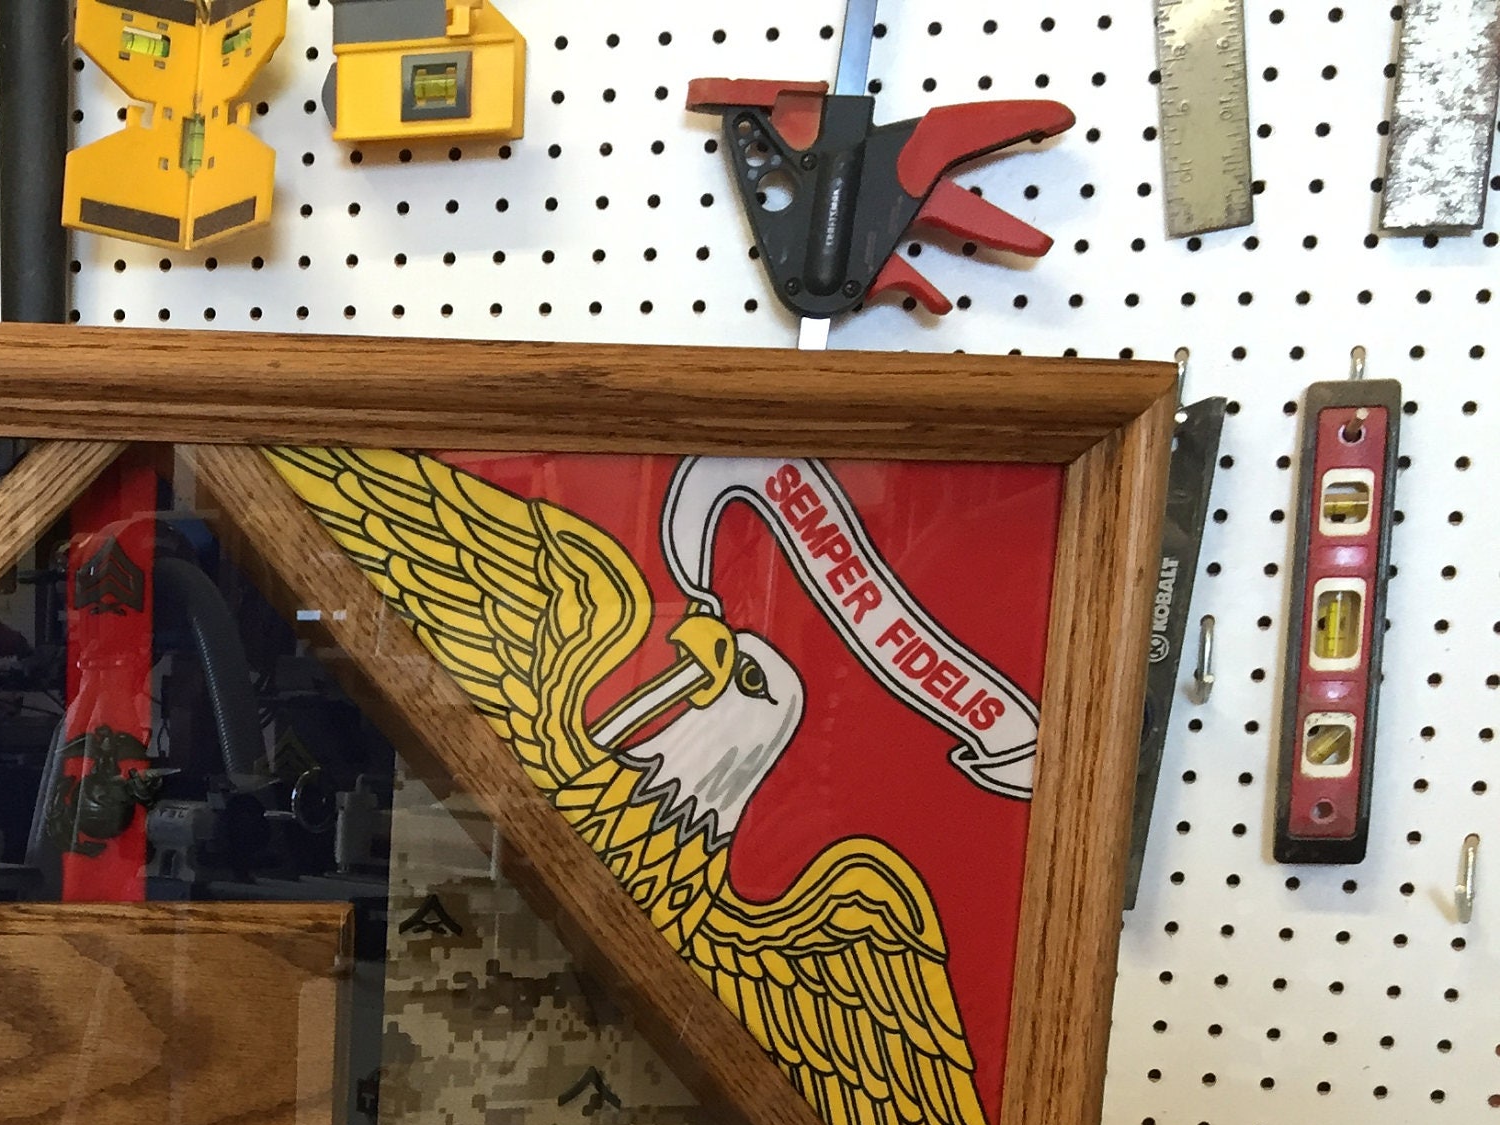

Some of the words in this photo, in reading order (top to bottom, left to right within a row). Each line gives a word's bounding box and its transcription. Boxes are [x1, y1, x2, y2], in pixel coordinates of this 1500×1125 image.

[765, 463, 882, 625] SEMPER
[875, 618, 1005, 731] FIDELIS
[1152, 557, 1179, 632] KOBALT
